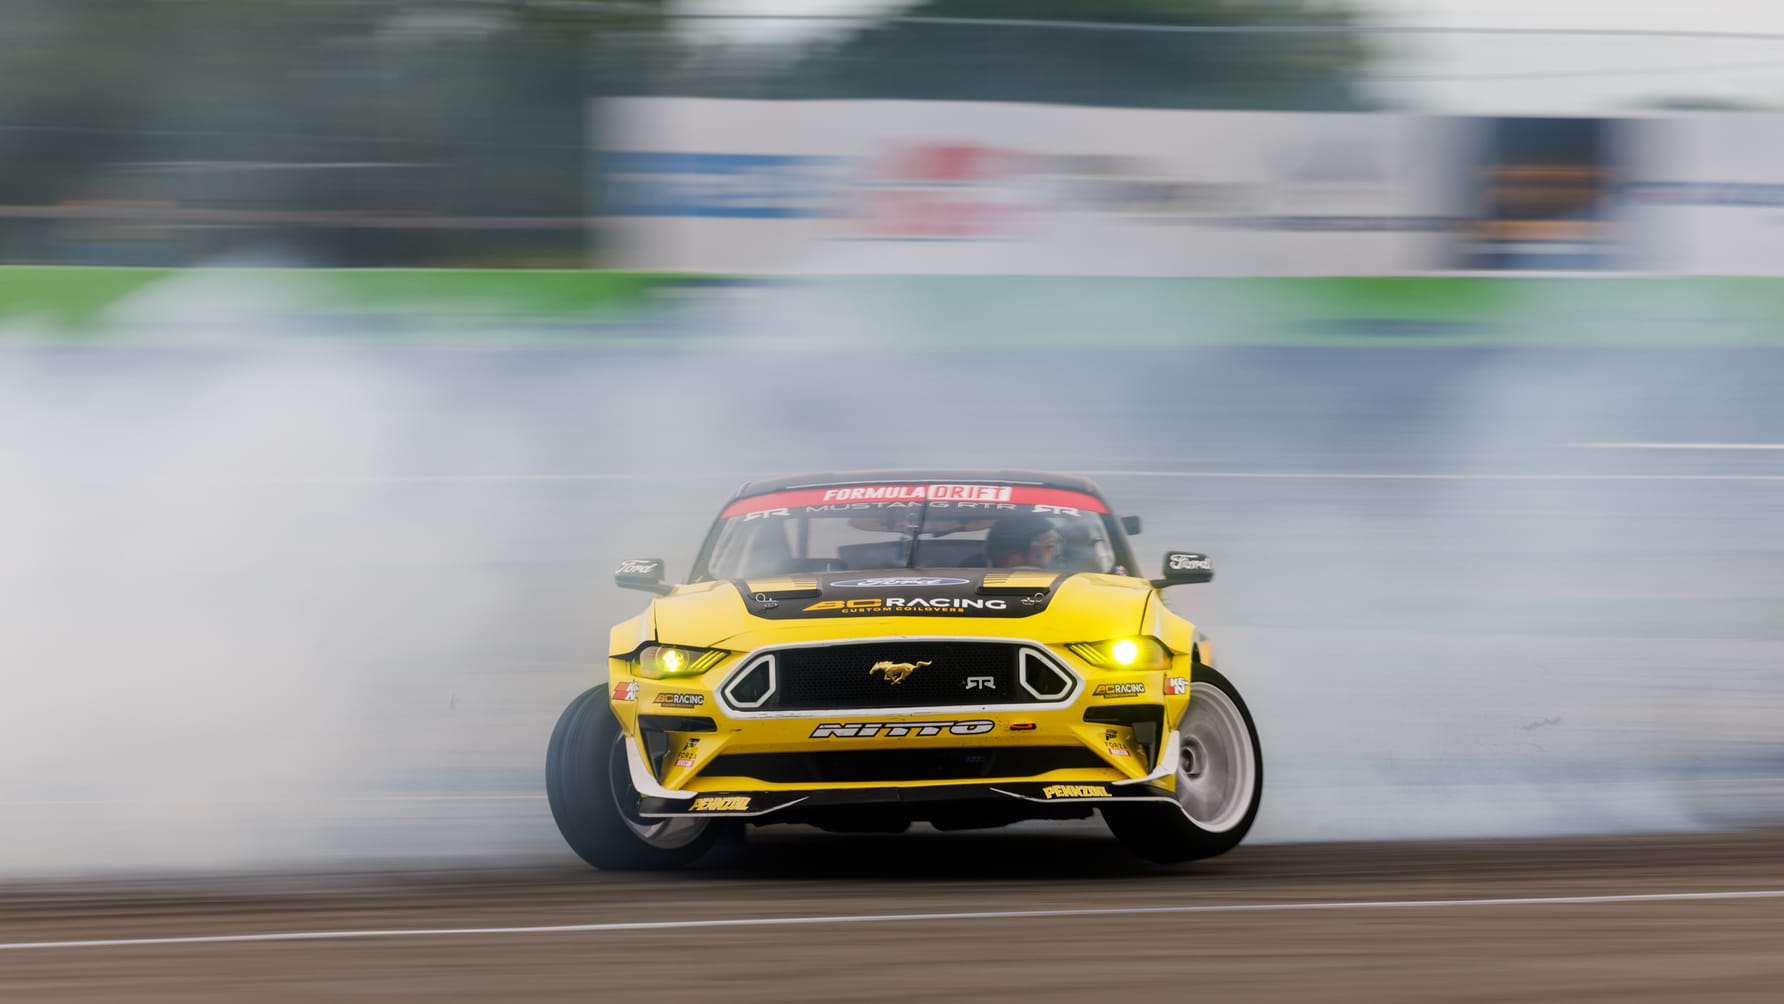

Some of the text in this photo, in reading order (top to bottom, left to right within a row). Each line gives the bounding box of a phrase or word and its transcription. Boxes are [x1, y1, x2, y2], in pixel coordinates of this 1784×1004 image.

[823, 486, 1008, 501] FORMULA DRIFT
[806, 501, 1017, 513] MUSTANG RTR
[1169, 554, 1213, 570] Ford
[841, 606, 965, 614] CUSTOM COILOVERS
[886, 598, 1007, 610] RACING
[1115, 683, 1145, 693] RACING
[673, 694, 704, 705] RACING
[809, 720, 995, 738] NITTO
[1042, 785, 1113, 799] PENNZOIL
[688, 797, 752, 811] PENNZOIL
